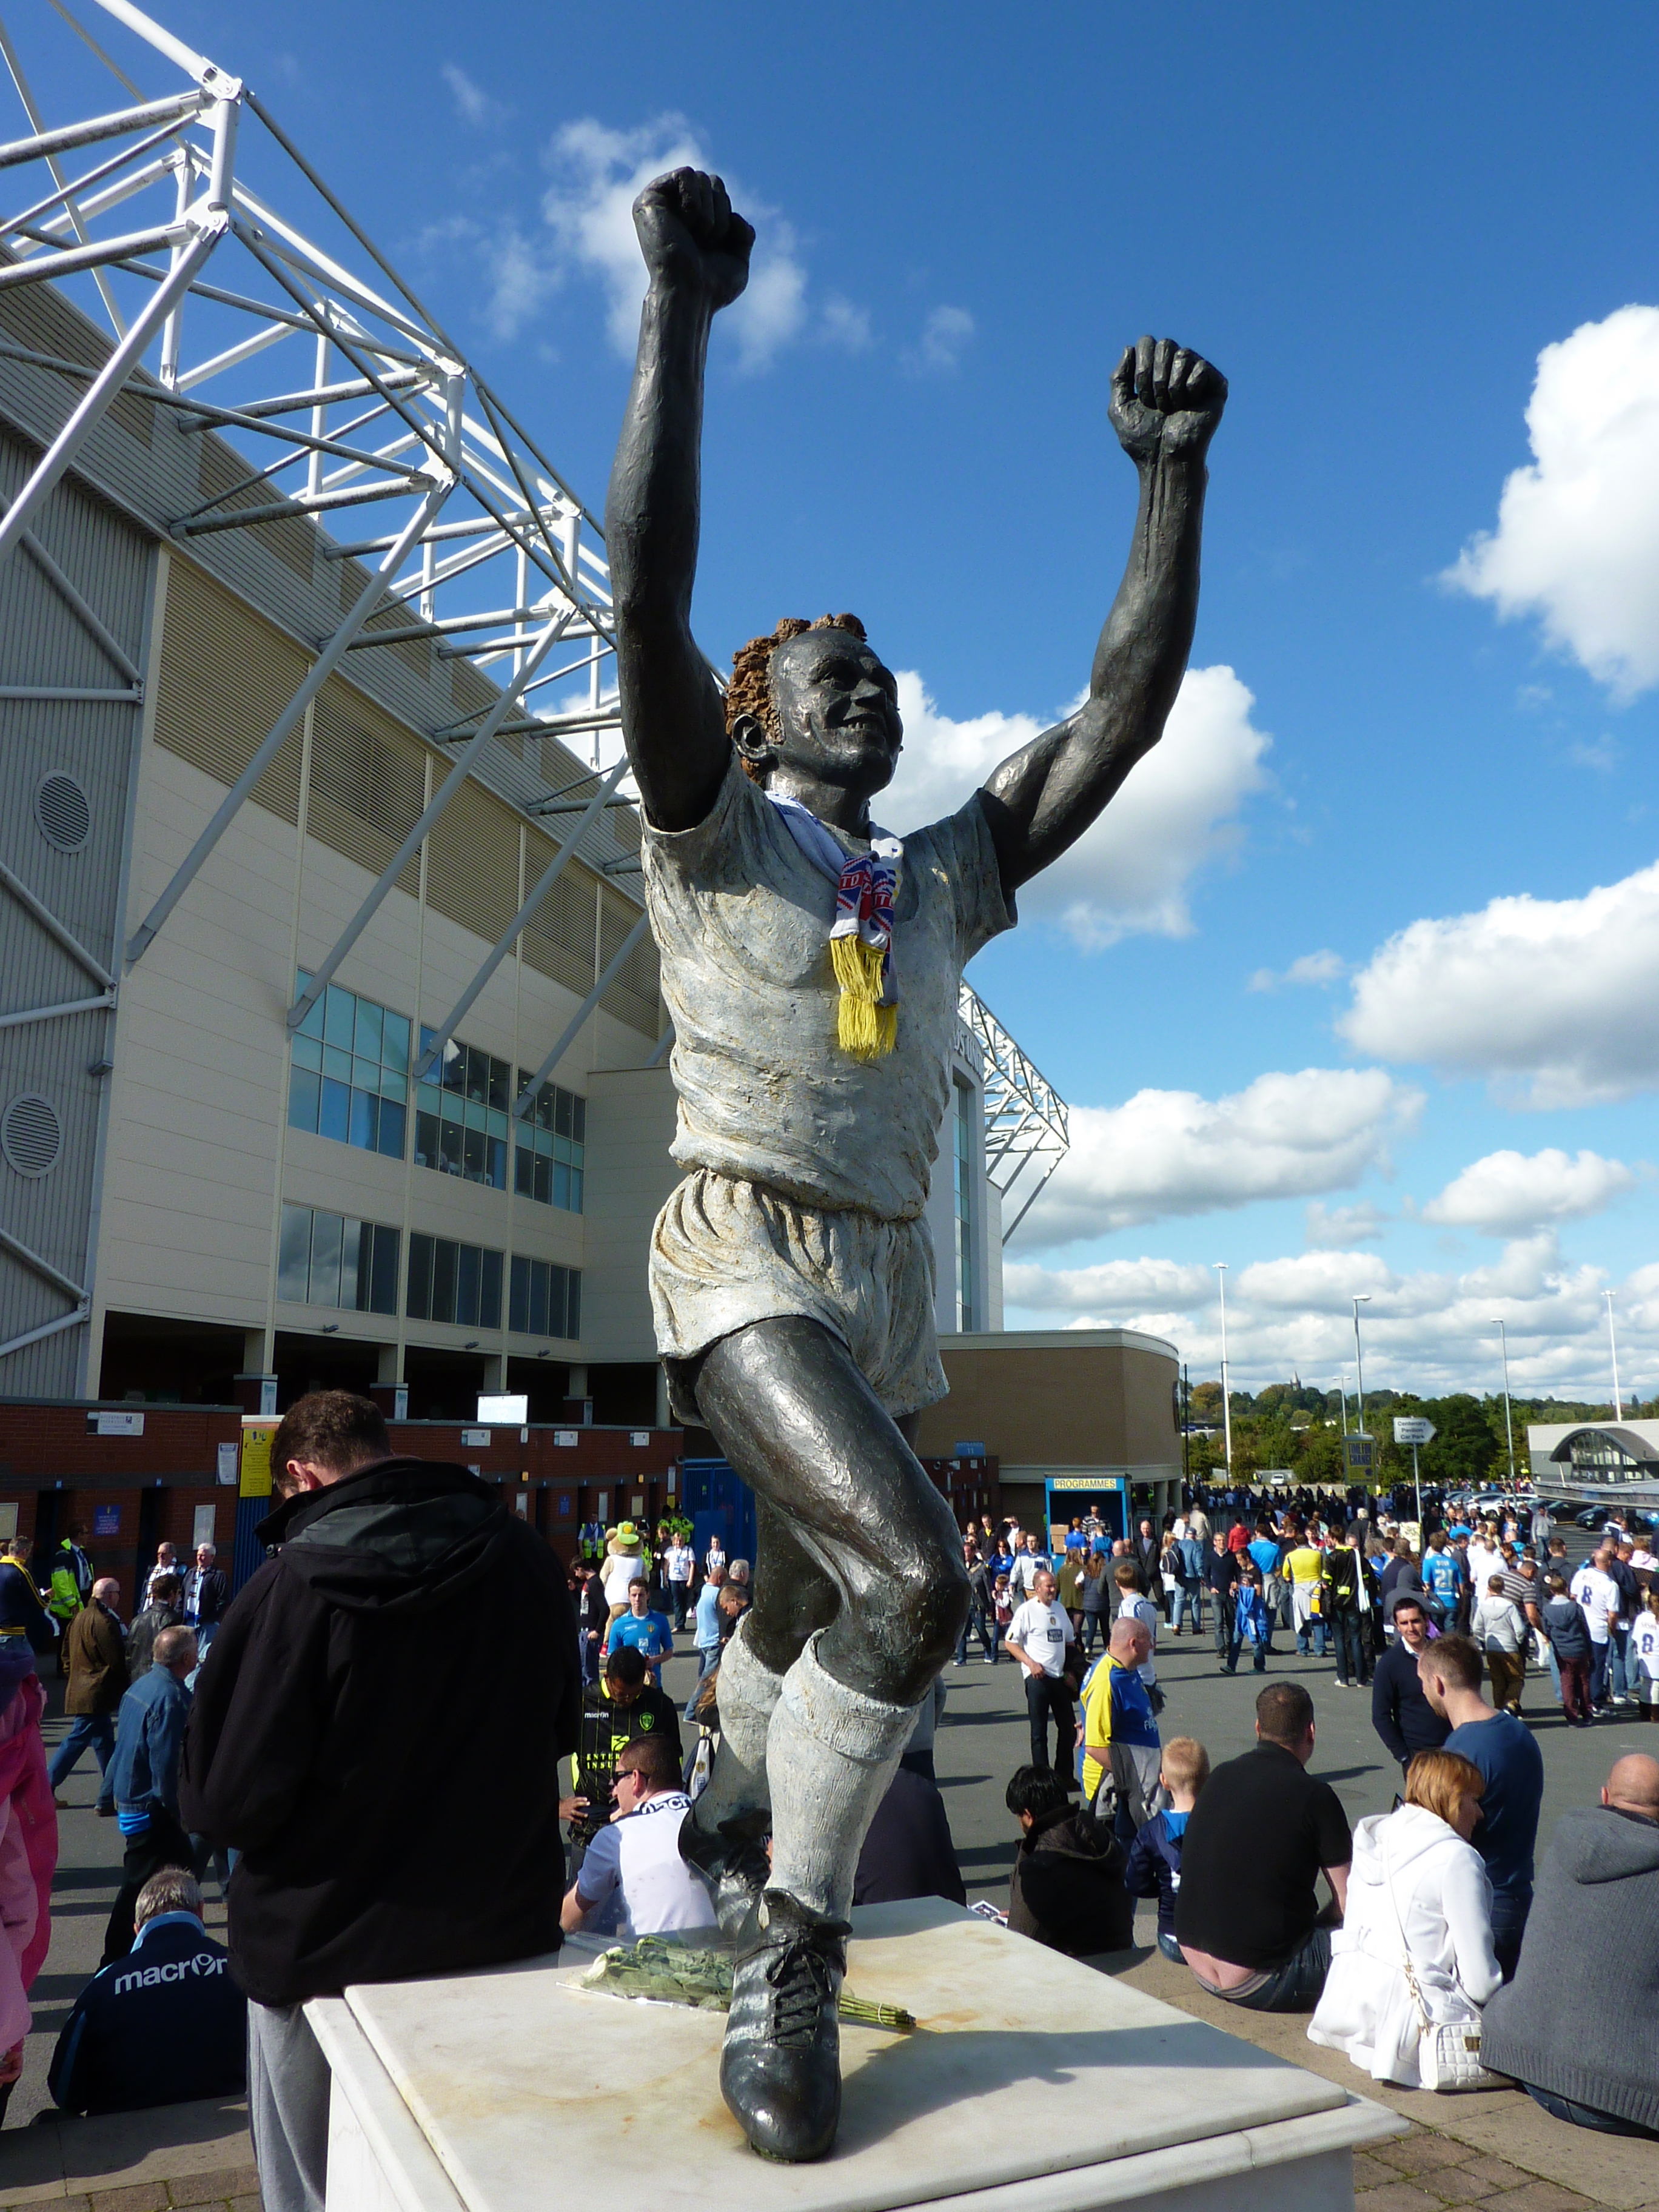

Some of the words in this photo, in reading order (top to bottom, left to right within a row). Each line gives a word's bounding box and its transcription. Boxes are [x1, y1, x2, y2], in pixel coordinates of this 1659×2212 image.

[1055, 1480, 1115, 1488] PROGRAMMES
[1435, 1569, 1453, 1588] 21
[1581, 1584, 1592, 1606] 8
[1641, 1632, 1654, 1654] 8
